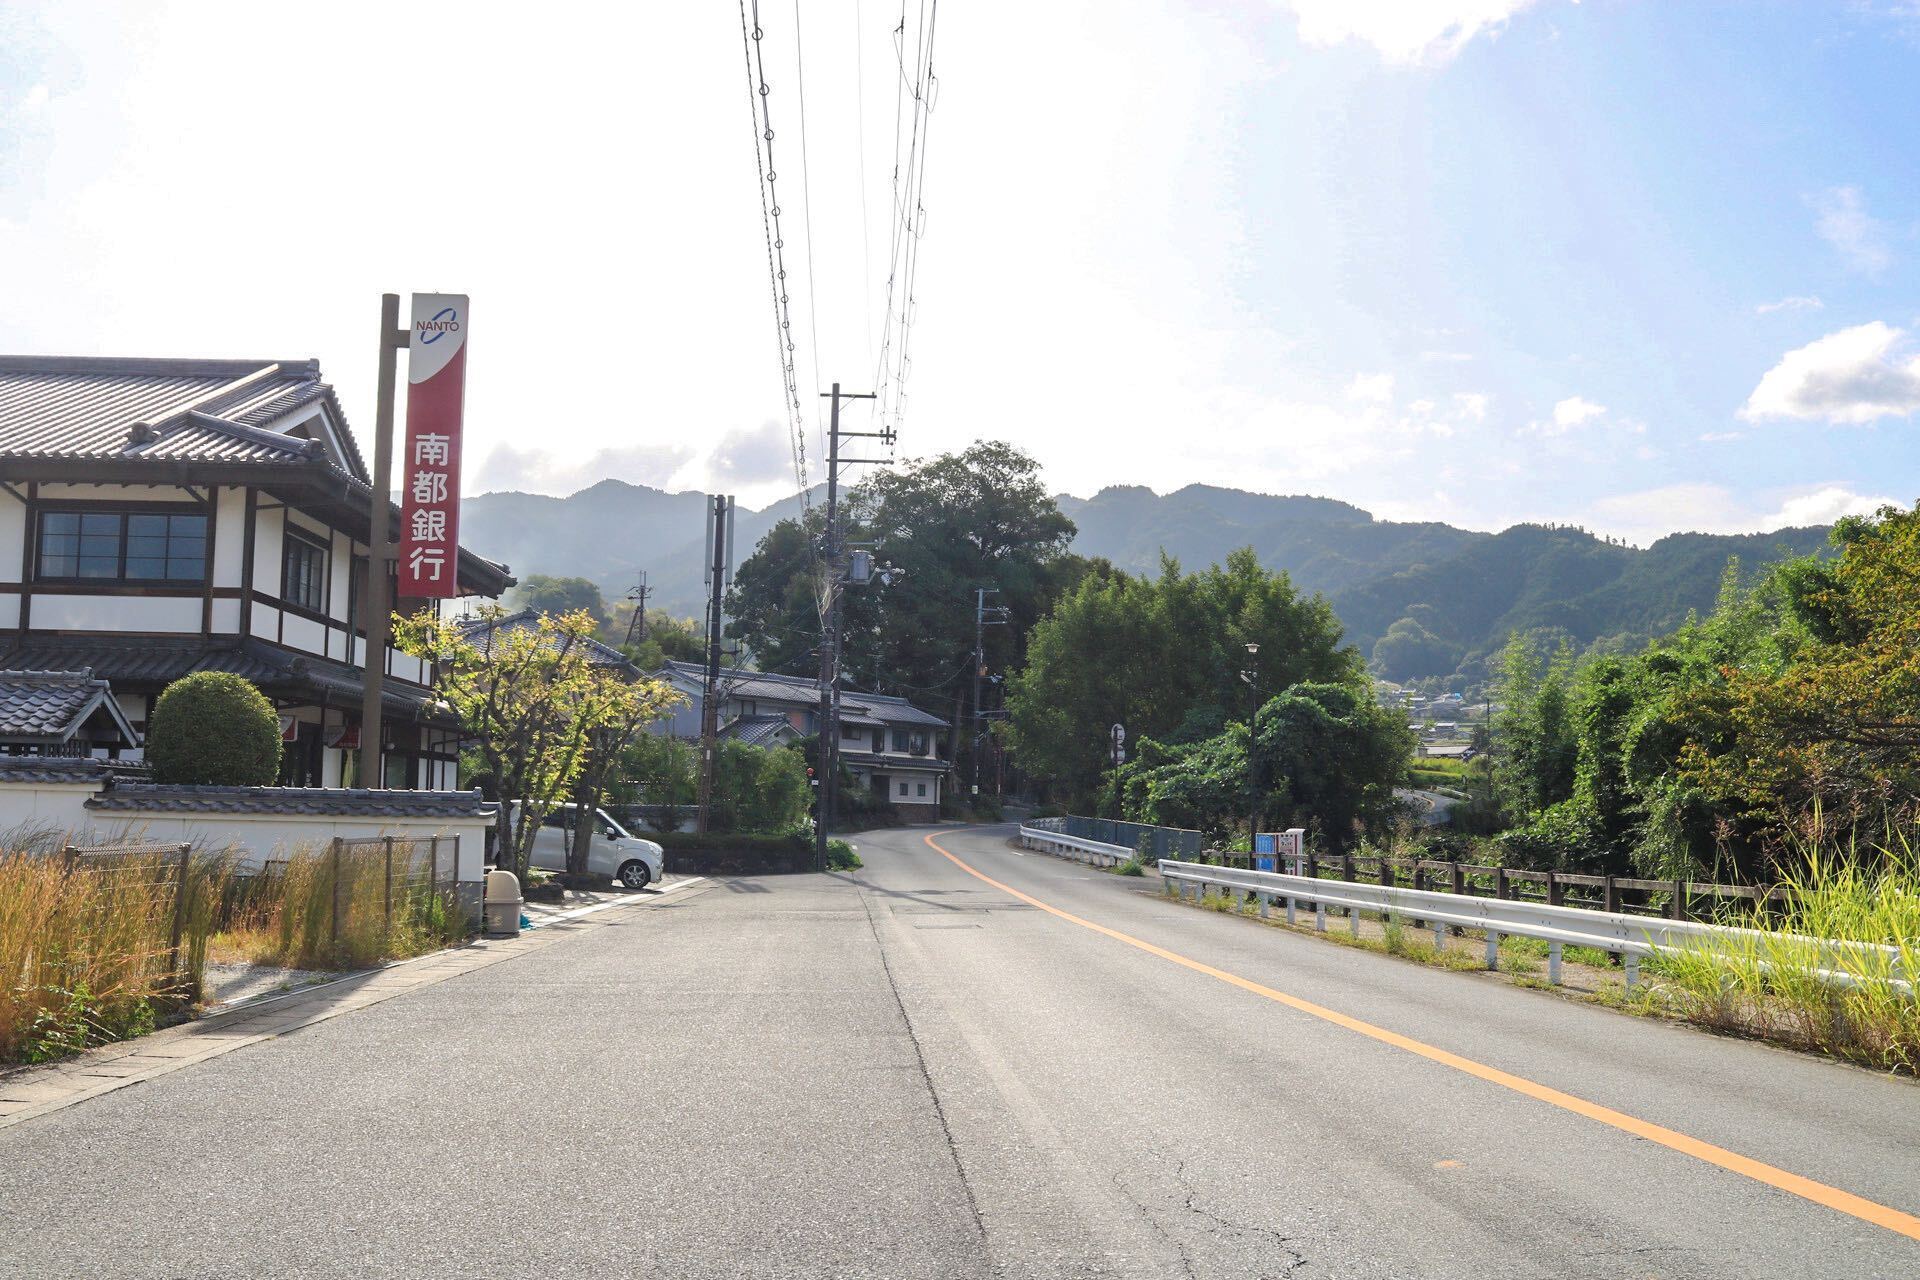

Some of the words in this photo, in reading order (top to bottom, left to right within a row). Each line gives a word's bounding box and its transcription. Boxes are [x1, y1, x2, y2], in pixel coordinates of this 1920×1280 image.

[416, 321, 460, 332] NANTO
[409, 432, 450, 581] 南都銀行
